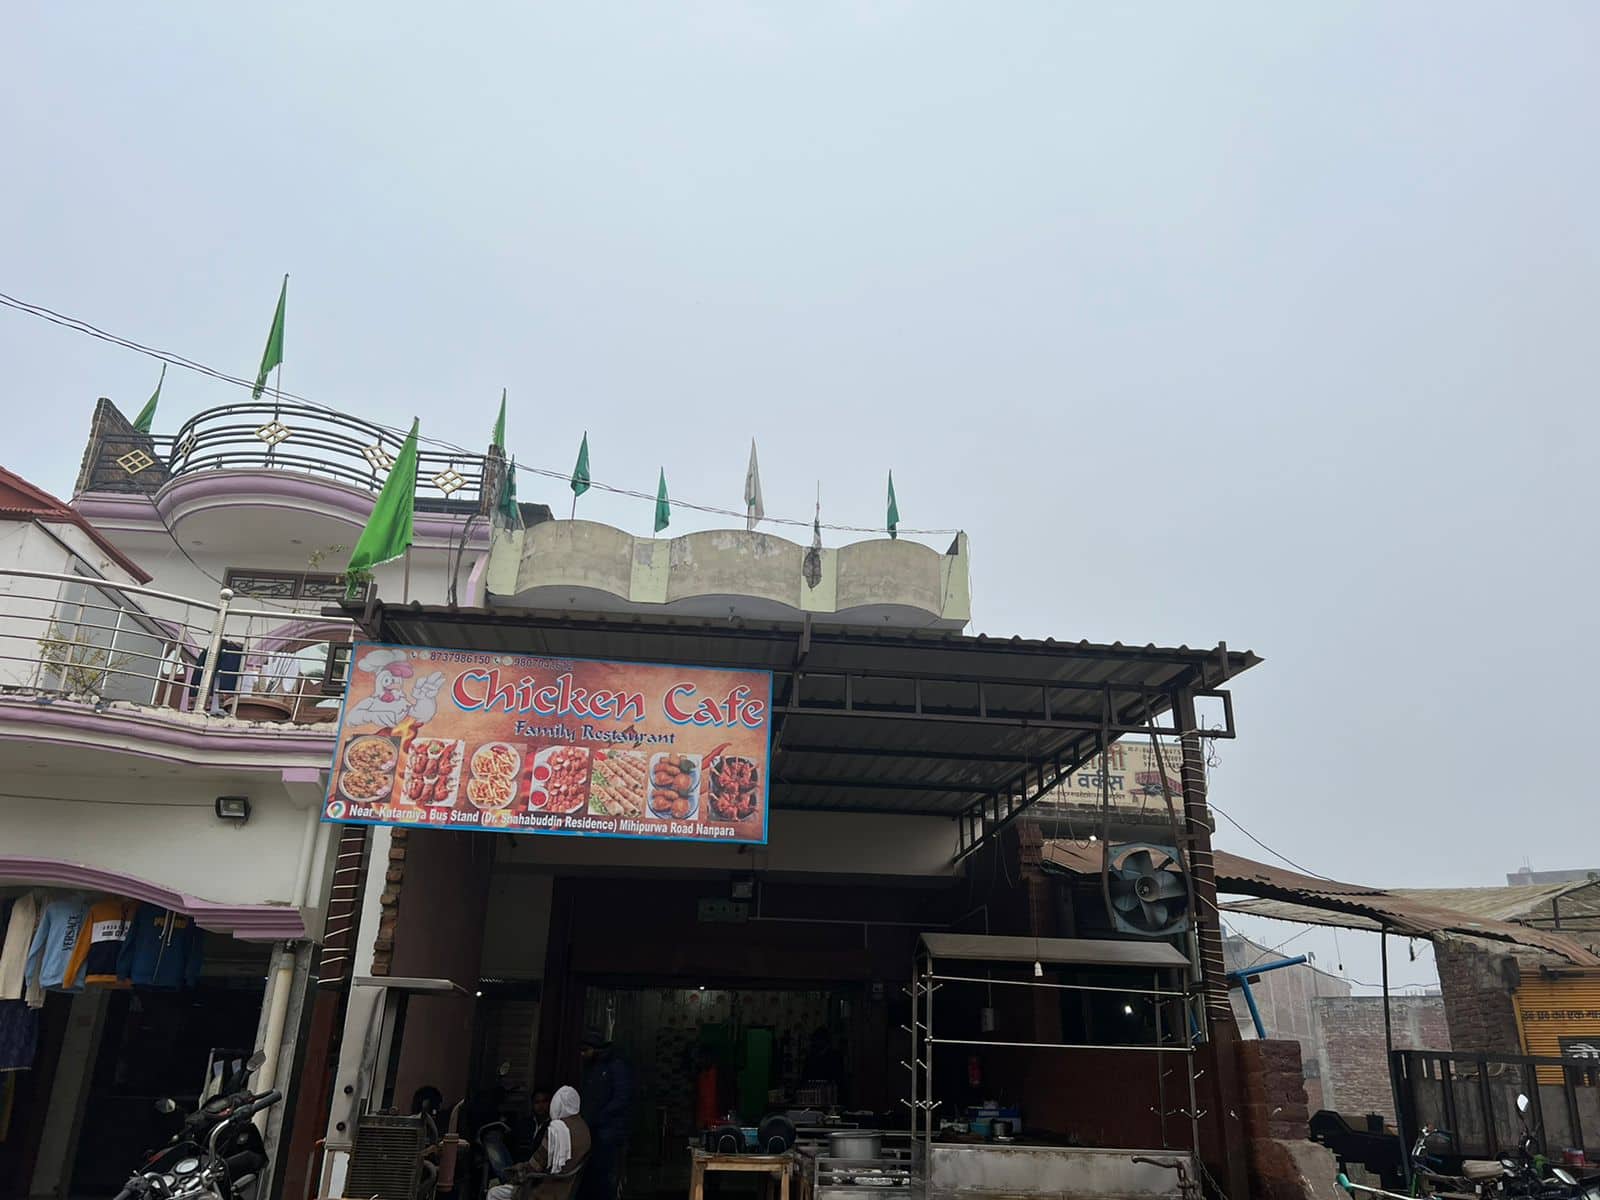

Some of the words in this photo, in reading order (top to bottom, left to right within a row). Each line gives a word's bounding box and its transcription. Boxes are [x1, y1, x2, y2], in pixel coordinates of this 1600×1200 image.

[430, 652, 490, 665] 8737986150
[451, 668, 647, 721] Chicken
[663, 682, 765, 728] Cafe
[514, 720, 576, 740] Family
[581, 724, 676, 745] Restaurant
[349, 804, 374, 817] Near
[430, 808, 448, 821] Bus
[451, 809, 479, 823] Stand
[481, 811, 497, 826] (Dr.
[564, 815, 618, 832] Residence)
[620, 819, 668, 835] Mihipurwa
[670, 822, 694, 834] Road
[696, 825, 735, 837] Nanpara
